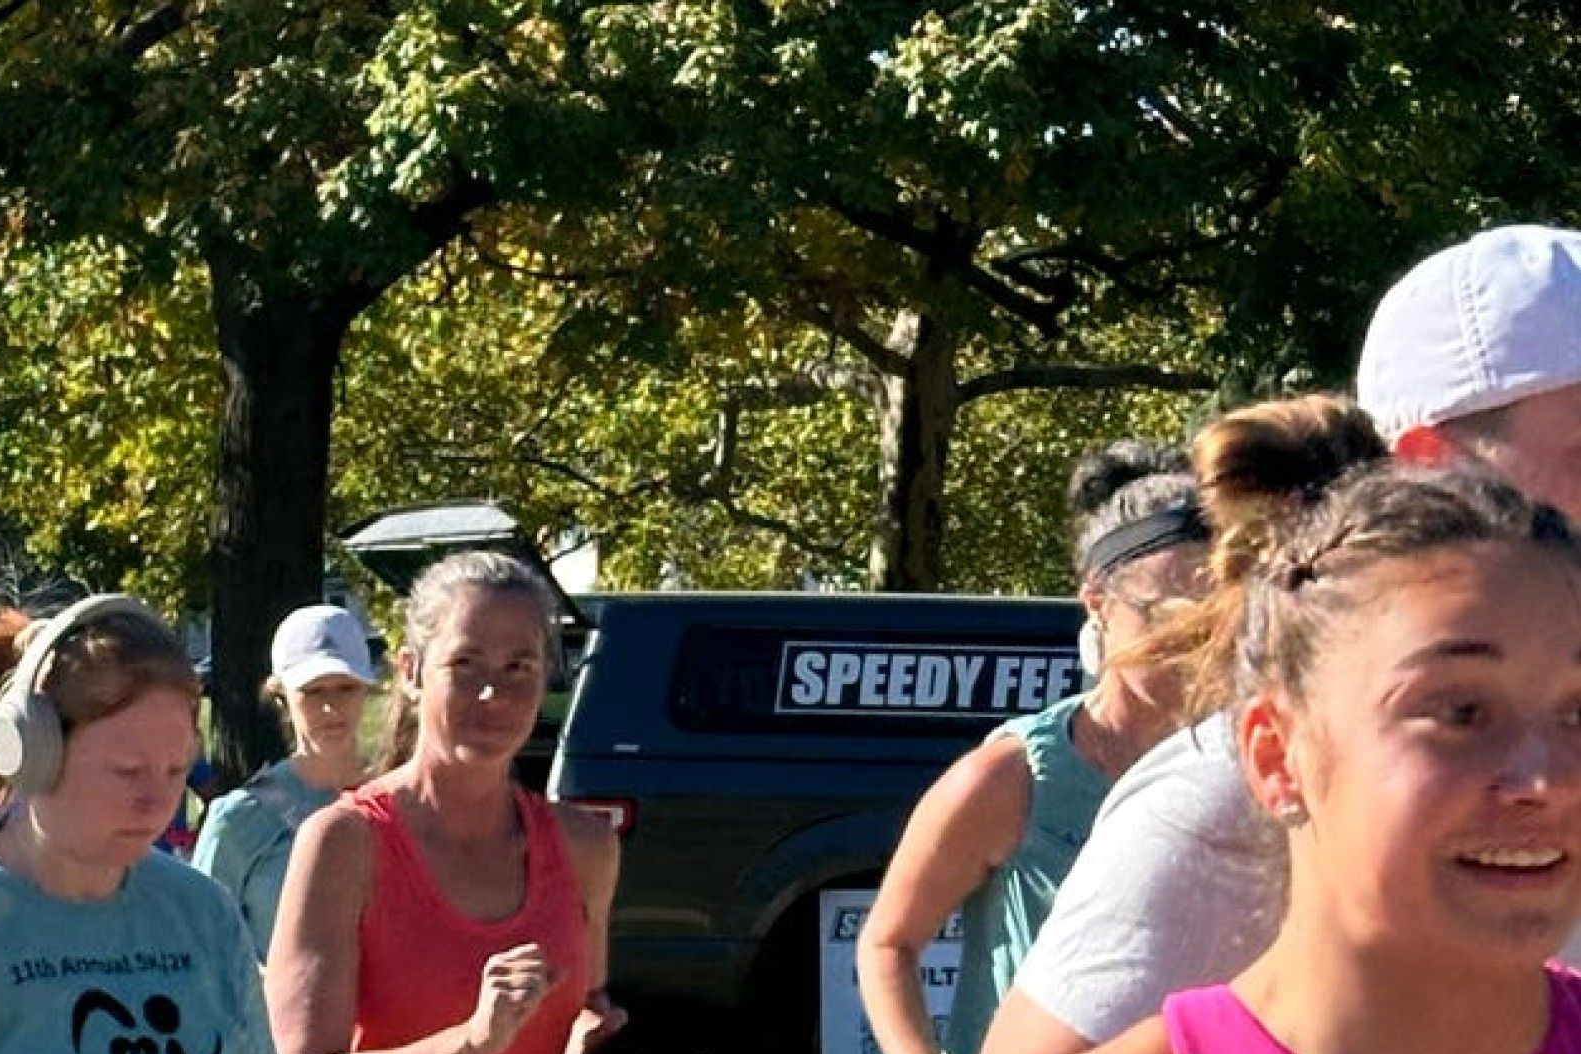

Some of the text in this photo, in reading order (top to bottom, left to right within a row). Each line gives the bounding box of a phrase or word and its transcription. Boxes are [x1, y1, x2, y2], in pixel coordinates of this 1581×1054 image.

[791, 651, 1081, 708] SPEEDY FEE
[61, 953, 134, 977] Annual
